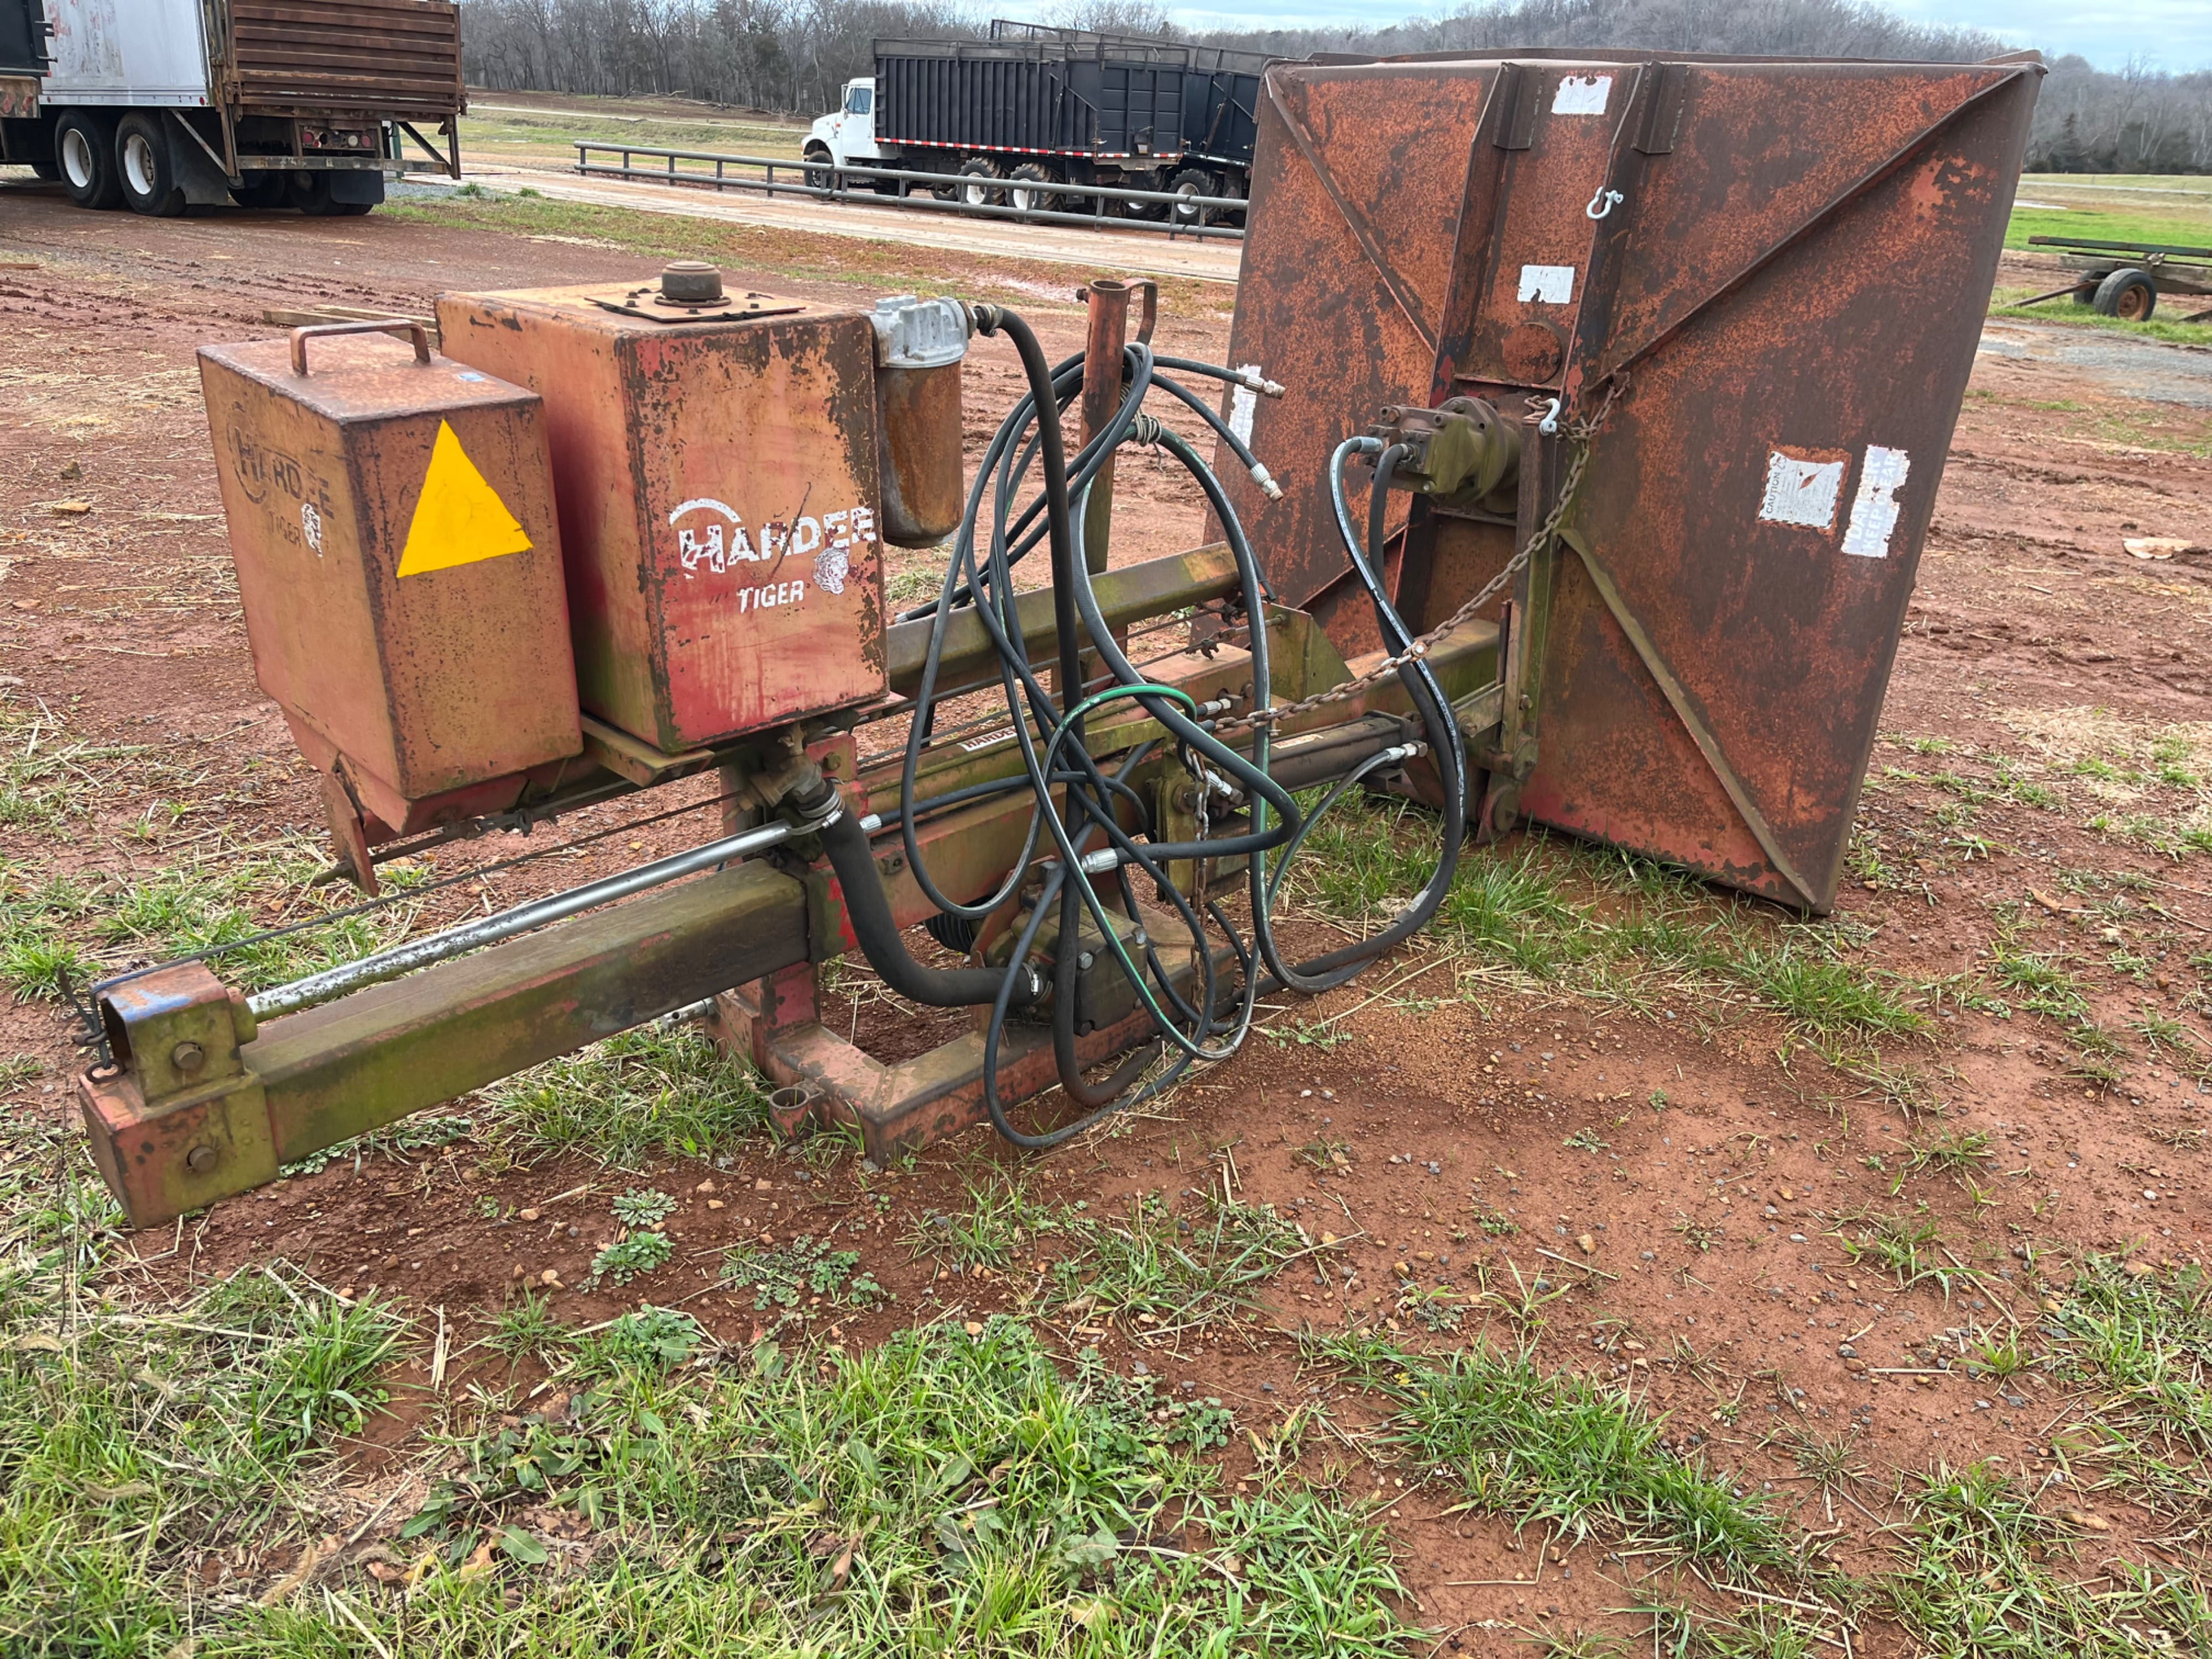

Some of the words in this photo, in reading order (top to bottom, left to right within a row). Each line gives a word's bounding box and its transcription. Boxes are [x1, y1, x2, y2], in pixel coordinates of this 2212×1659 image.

[1766, 472, 1781, 514] CAUTION
[678, 505, 877, 574] HARDEE
[1862, 507, 1884, 550] KEEP
[736, 580, 804, 614] TIGER
